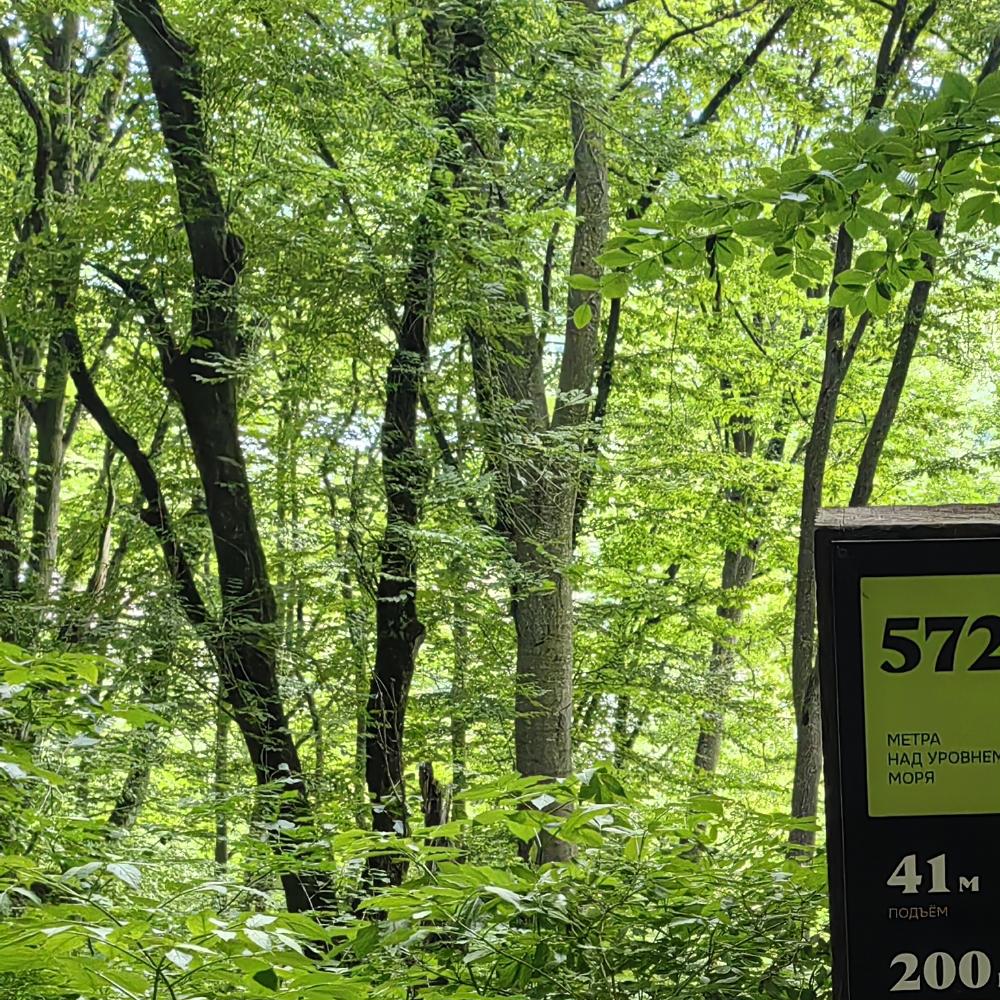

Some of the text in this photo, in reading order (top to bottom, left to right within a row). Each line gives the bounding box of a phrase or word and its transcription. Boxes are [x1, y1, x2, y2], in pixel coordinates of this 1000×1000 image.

[887, 732, 941, 747] МЕТРА
[888, 752, 923, 768] НАД
[888, 770, 935, 785] МОРЯ
[887, 853, 951, 894] 41
[888, 904, 948, 920] ПОДЪЁМ
[890, 950, 991, 991] 200
